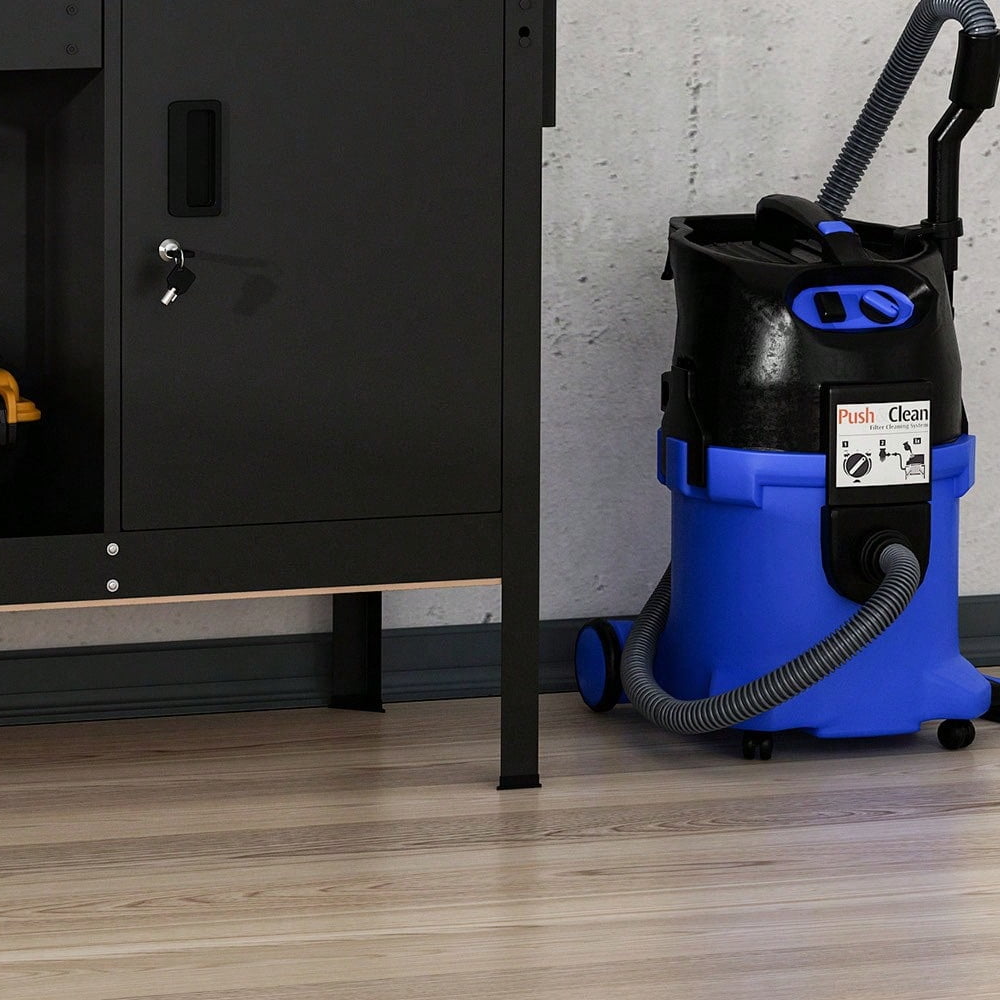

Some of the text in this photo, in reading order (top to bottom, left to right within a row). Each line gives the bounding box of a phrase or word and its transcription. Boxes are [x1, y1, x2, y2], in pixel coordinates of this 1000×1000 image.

[838, 405, 929, 425] Push Clean
[885, 422, 909, 430] Cleaning
[910, 421, 929, 429] System
